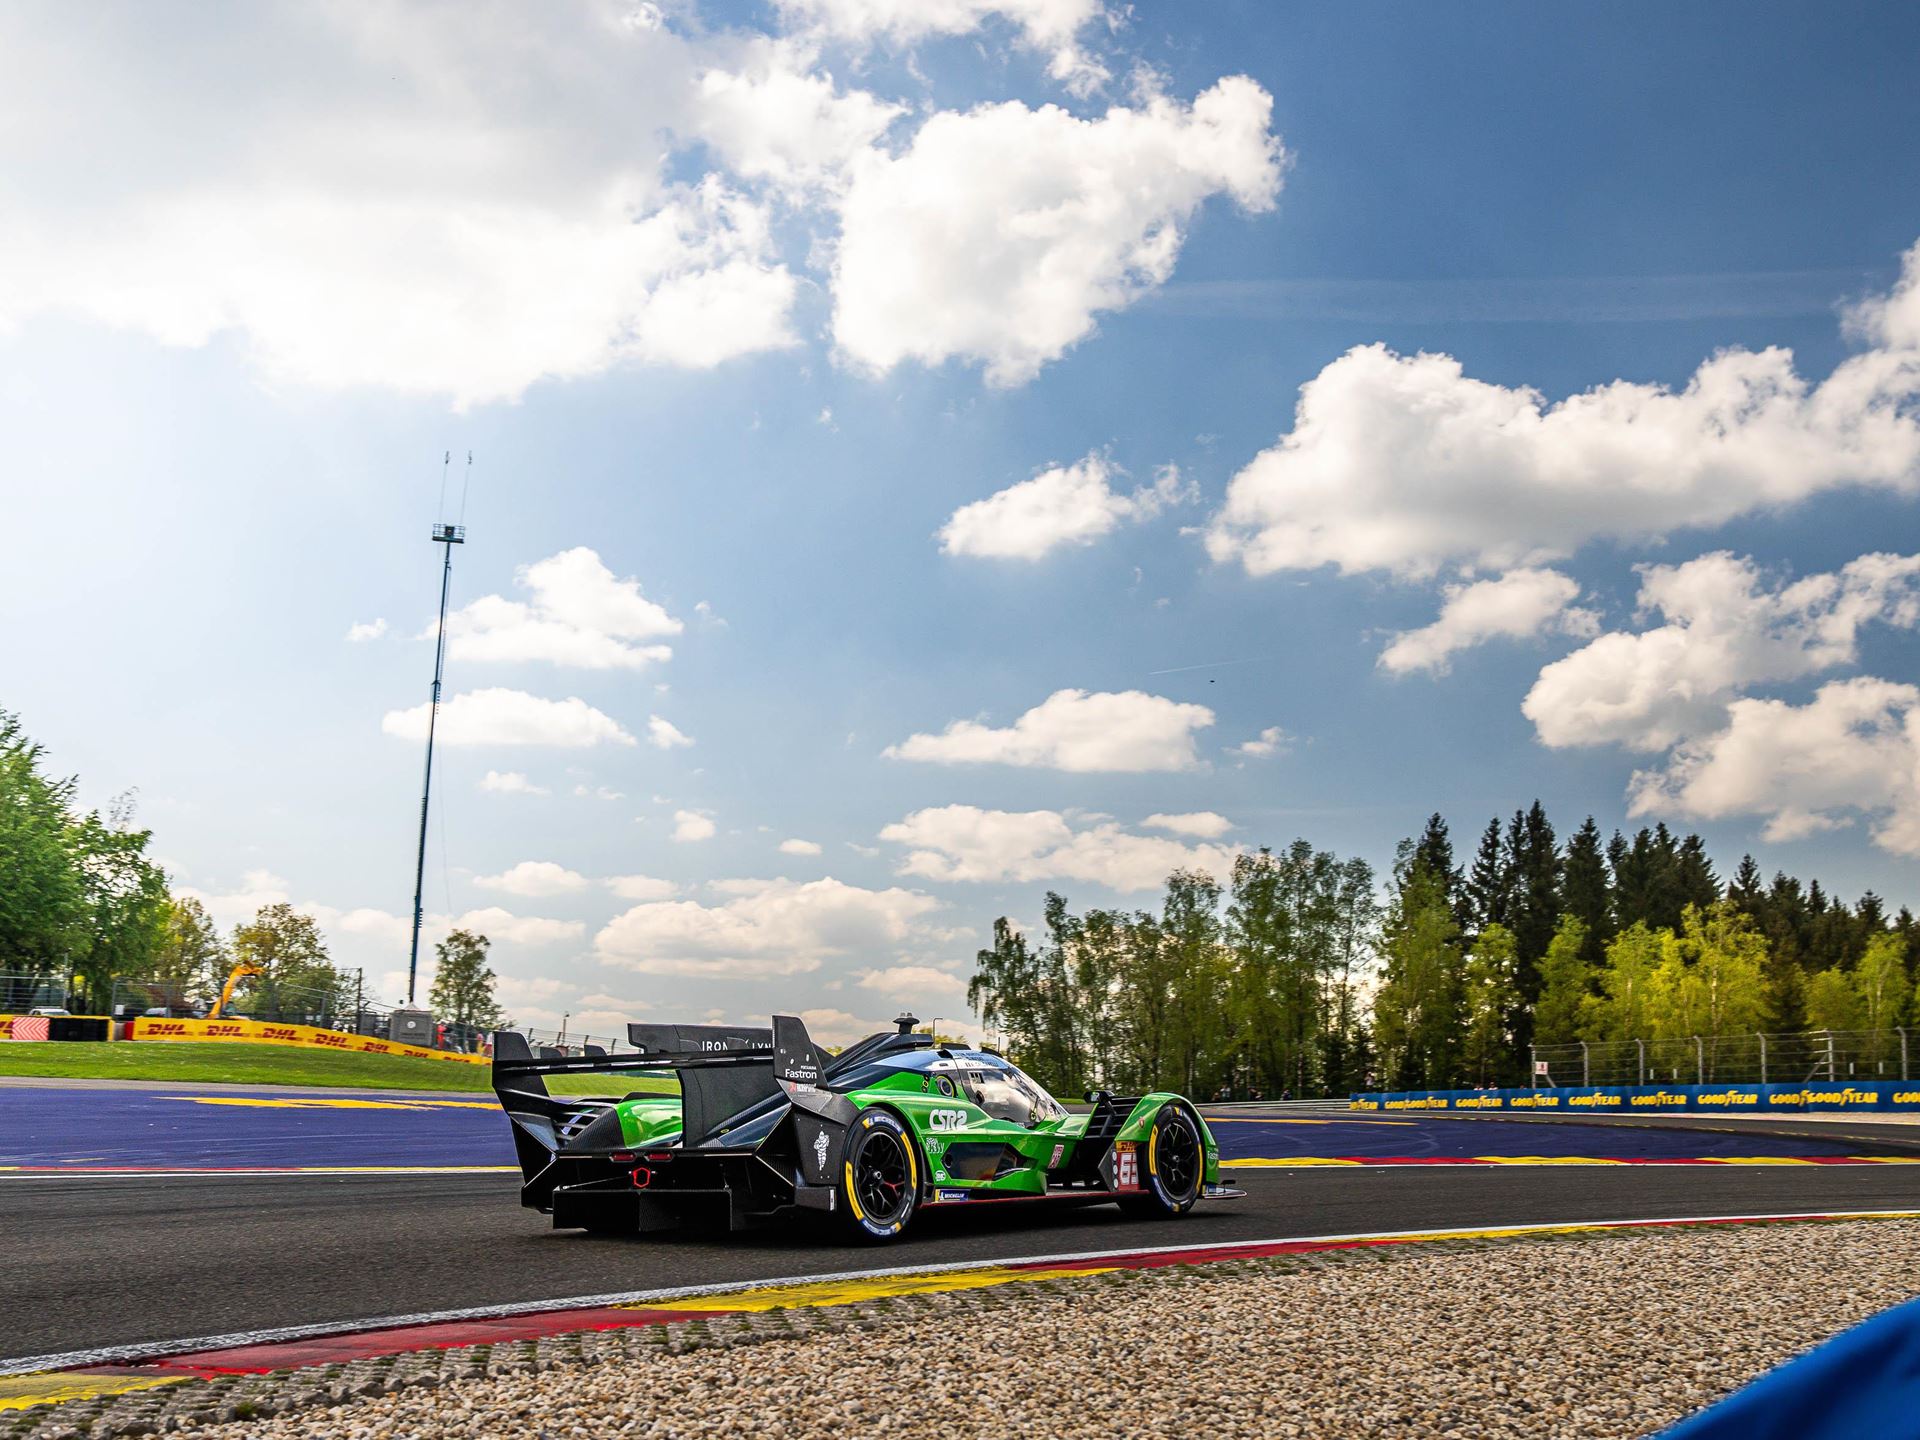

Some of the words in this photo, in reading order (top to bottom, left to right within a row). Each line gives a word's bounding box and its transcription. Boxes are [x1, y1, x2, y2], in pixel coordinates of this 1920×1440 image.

[147, 1024, 186, 1035] DHL
[206, 1025, 242, 1036] DHL
[262, 1028, 298, 1040] DHL
[315, 1033, 348, 1048] DHL
[785, 1068, 818, 1079] Fastron
[1455, 1095, 1503, 1109] GOODYEAR
[1510, 1094, 1559, 1108] GOODYEAR
[1568, 1092, 1622, 1107] GOODYEAR
[1630, 1091, 1687, 1107] GOODYEAR
[1697, 1090, 1758, 1106] GOODYEAR
[1807, 1088, 1878, 1106] GOODYEAR
[929, 1108, 969, 1132] CSR2
